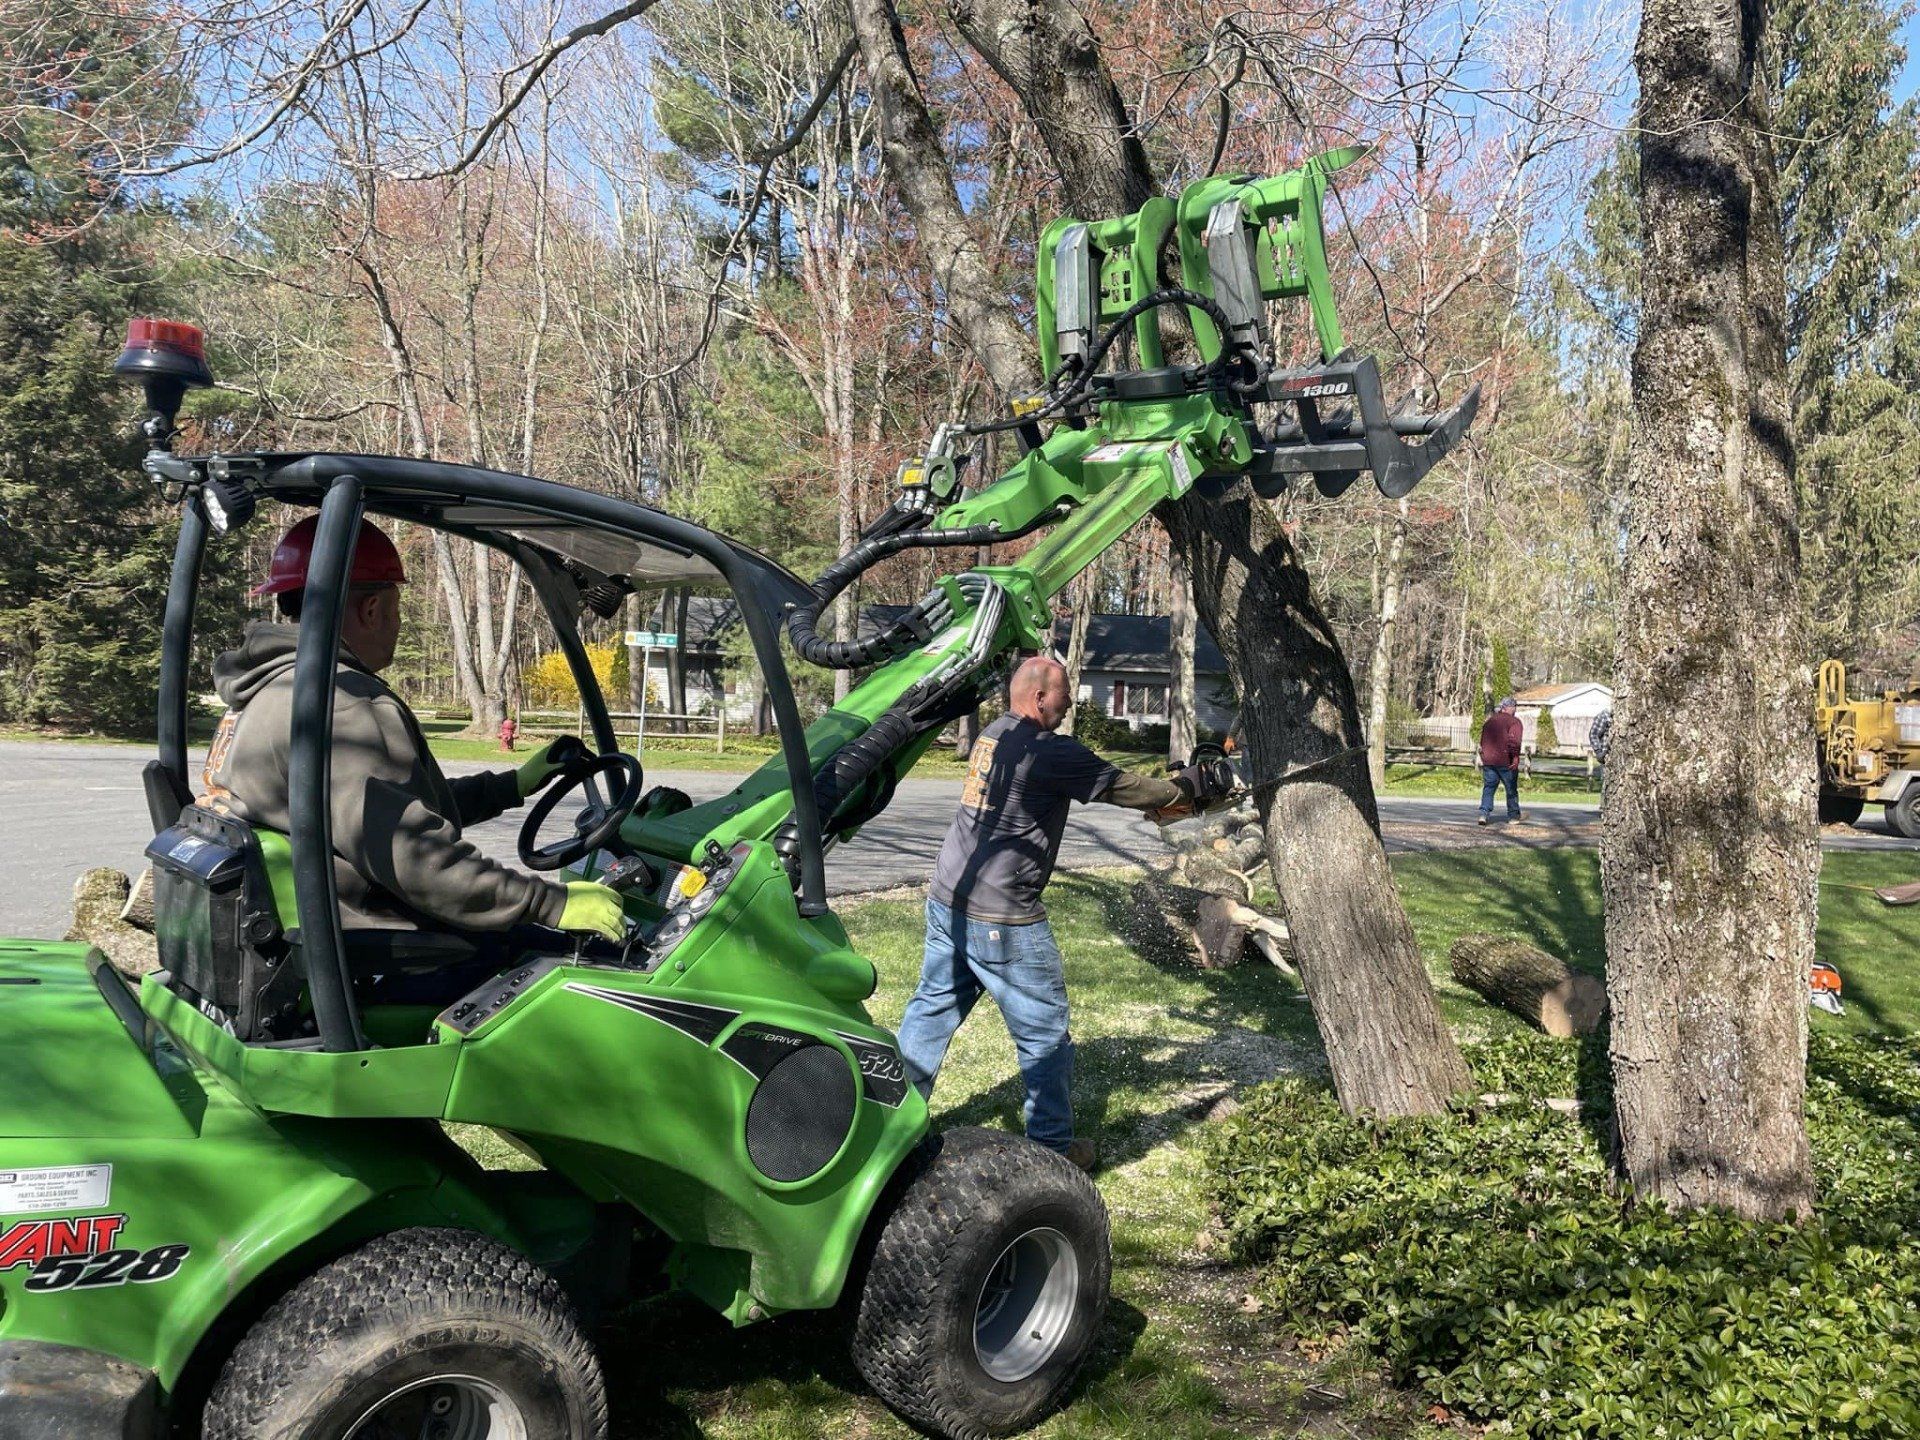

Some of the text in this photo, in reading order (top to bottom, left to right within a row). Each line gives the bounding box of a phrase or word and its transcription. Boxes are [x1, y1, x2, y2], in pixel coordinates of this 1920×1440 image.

[1302, 382, 1349, 398] 1300
[859, 1050, 906, 1082] 528
[48, 1170, 85, 1180] EQUIPMENT
[86, 1169, 98, 1177] INC
[24, 1245, 191, 1293] 528
